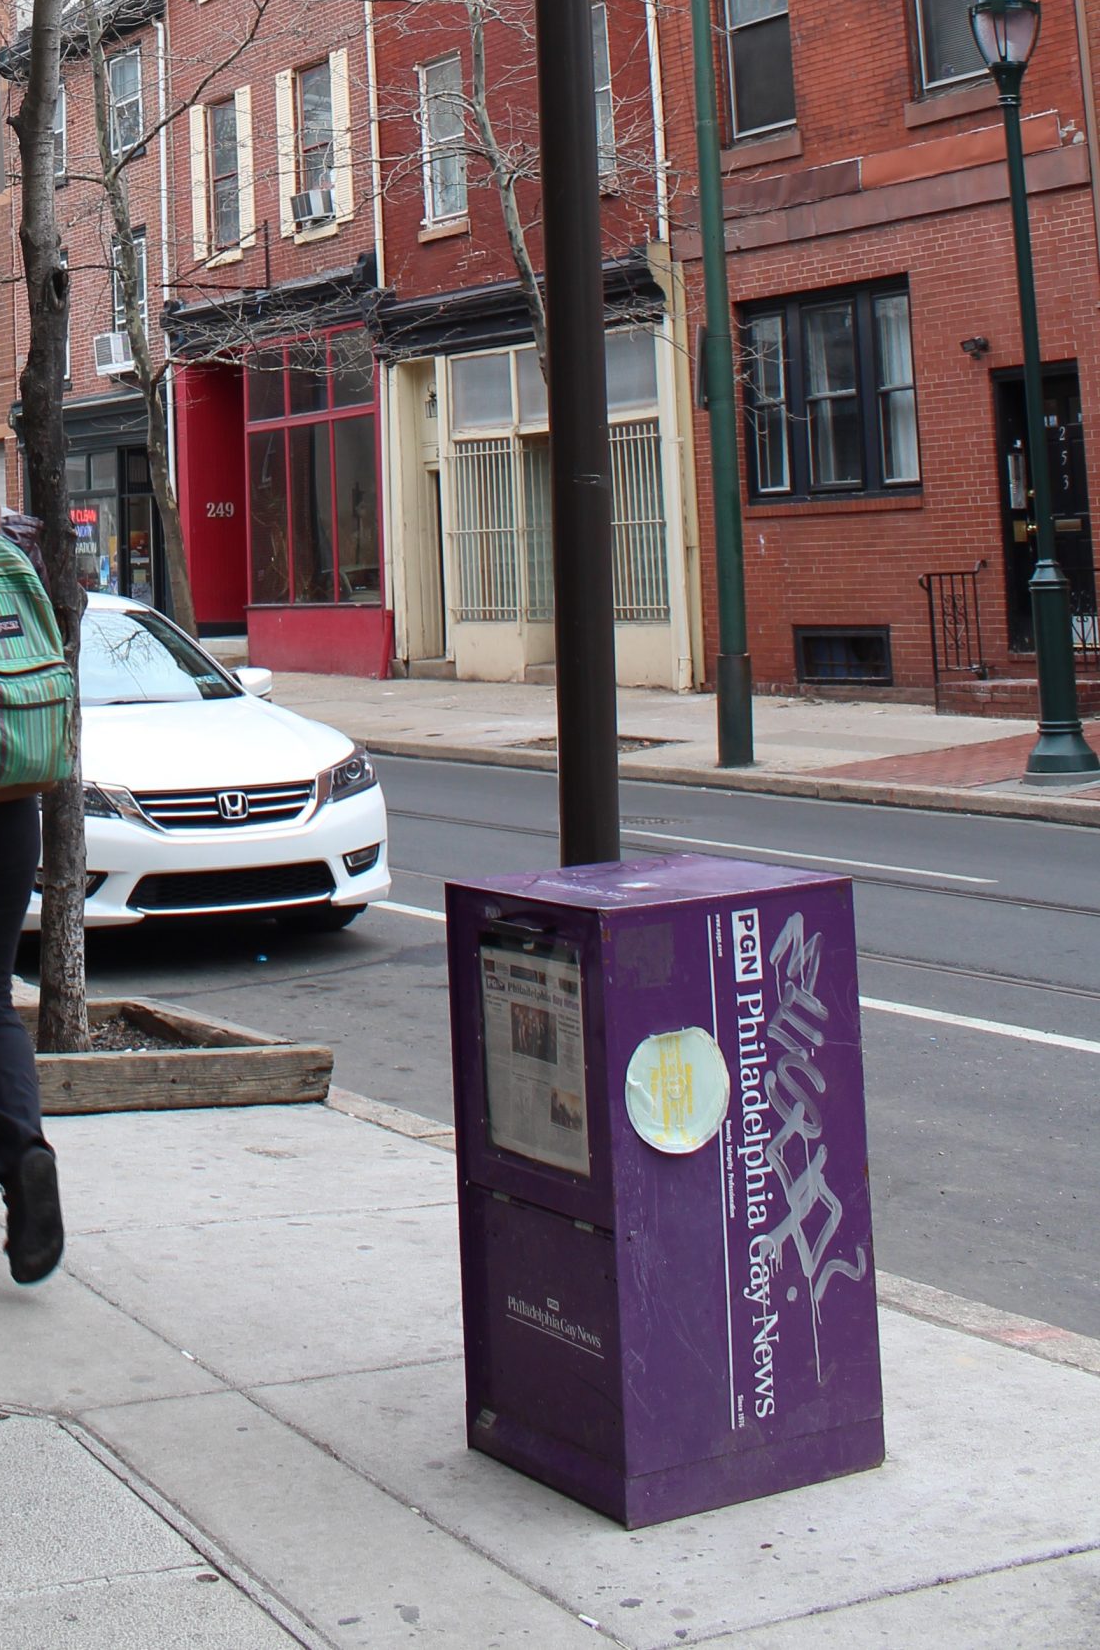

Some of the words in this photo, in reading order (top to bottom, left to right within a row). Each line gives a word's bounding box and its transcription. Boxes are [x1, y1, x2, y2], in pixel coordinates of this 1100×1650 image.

[206, 502, 234, 517] 249
[737, 913, 758, 976] PGN
[736, 989, 774, 1230] Philadelphia
[743, 1234, 778, 1306] Gay
[507, 1295, 561, 1329] Philadelphia
[560, 1317, 578, 1340] Gay
[577, 1324, 602, 1349] News
[752, 1310, 780, 1419] News
